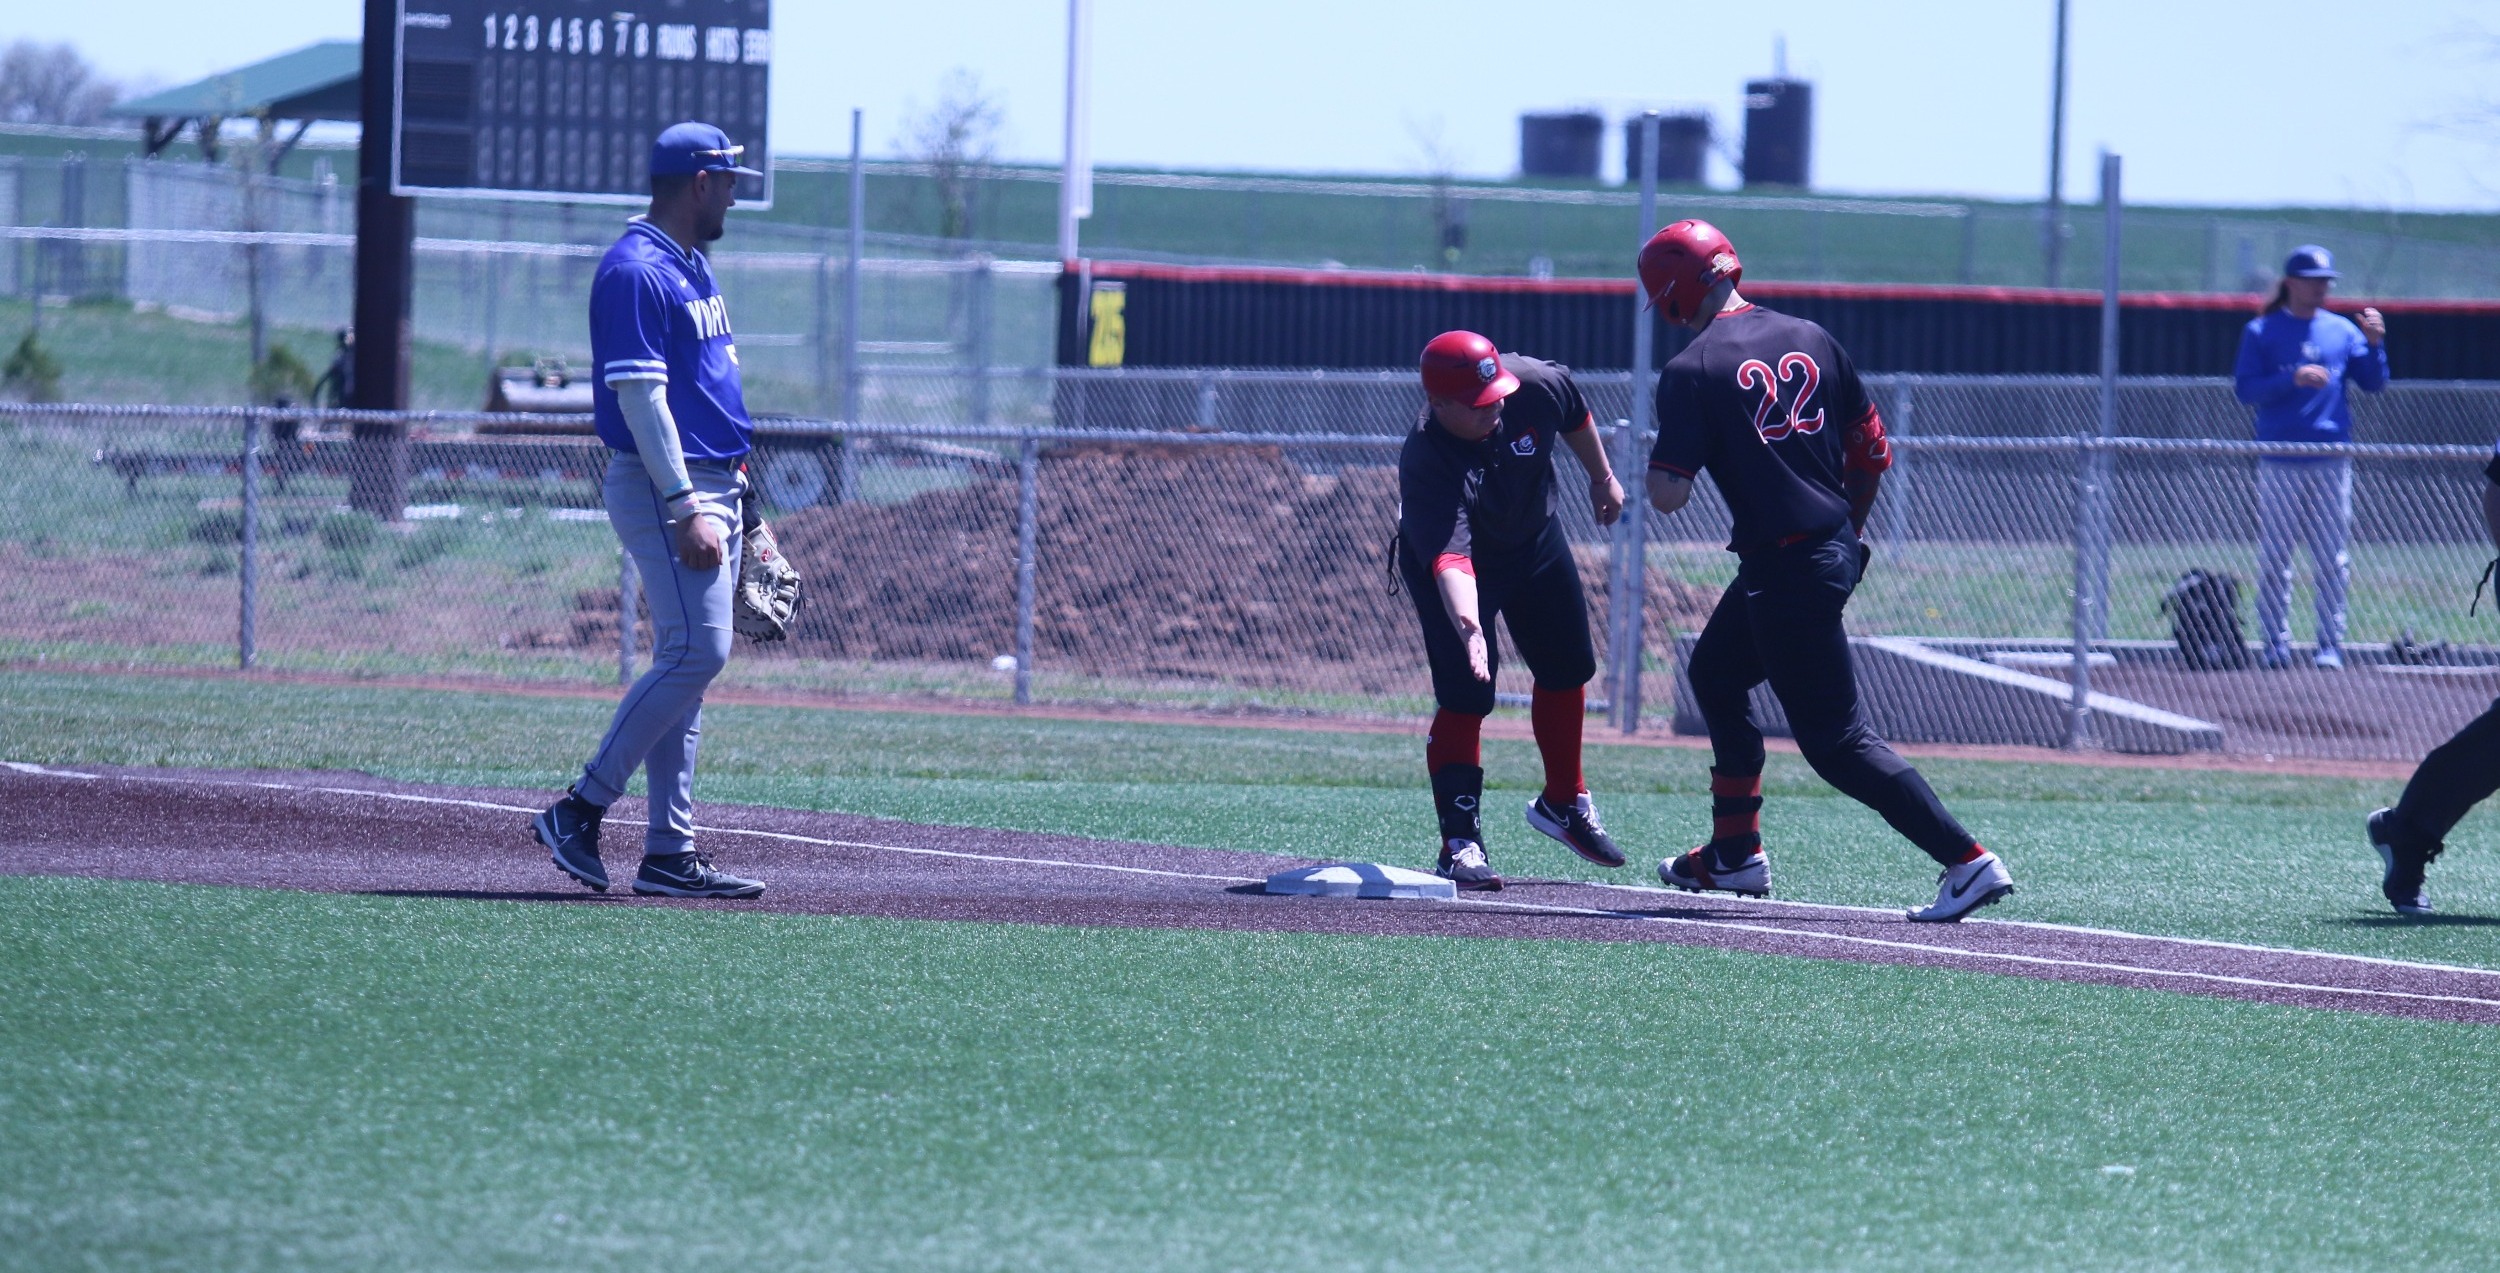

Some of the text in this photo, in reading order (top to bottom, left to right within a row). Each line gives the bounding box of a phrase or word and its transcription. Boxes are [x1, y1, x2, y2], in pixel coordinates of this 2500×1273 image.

[483, 13, 497, 49] 1
[503, 13, 518, 50] 2
[523, 15, 539, 52] 3
[548, 17, 563, 52] 4
[568, 17, 583, 55] 5
[588, 19, 604, 55] 6
[633, 22, 649, 58] 8
[1737, 351, 1824, 444] 22
